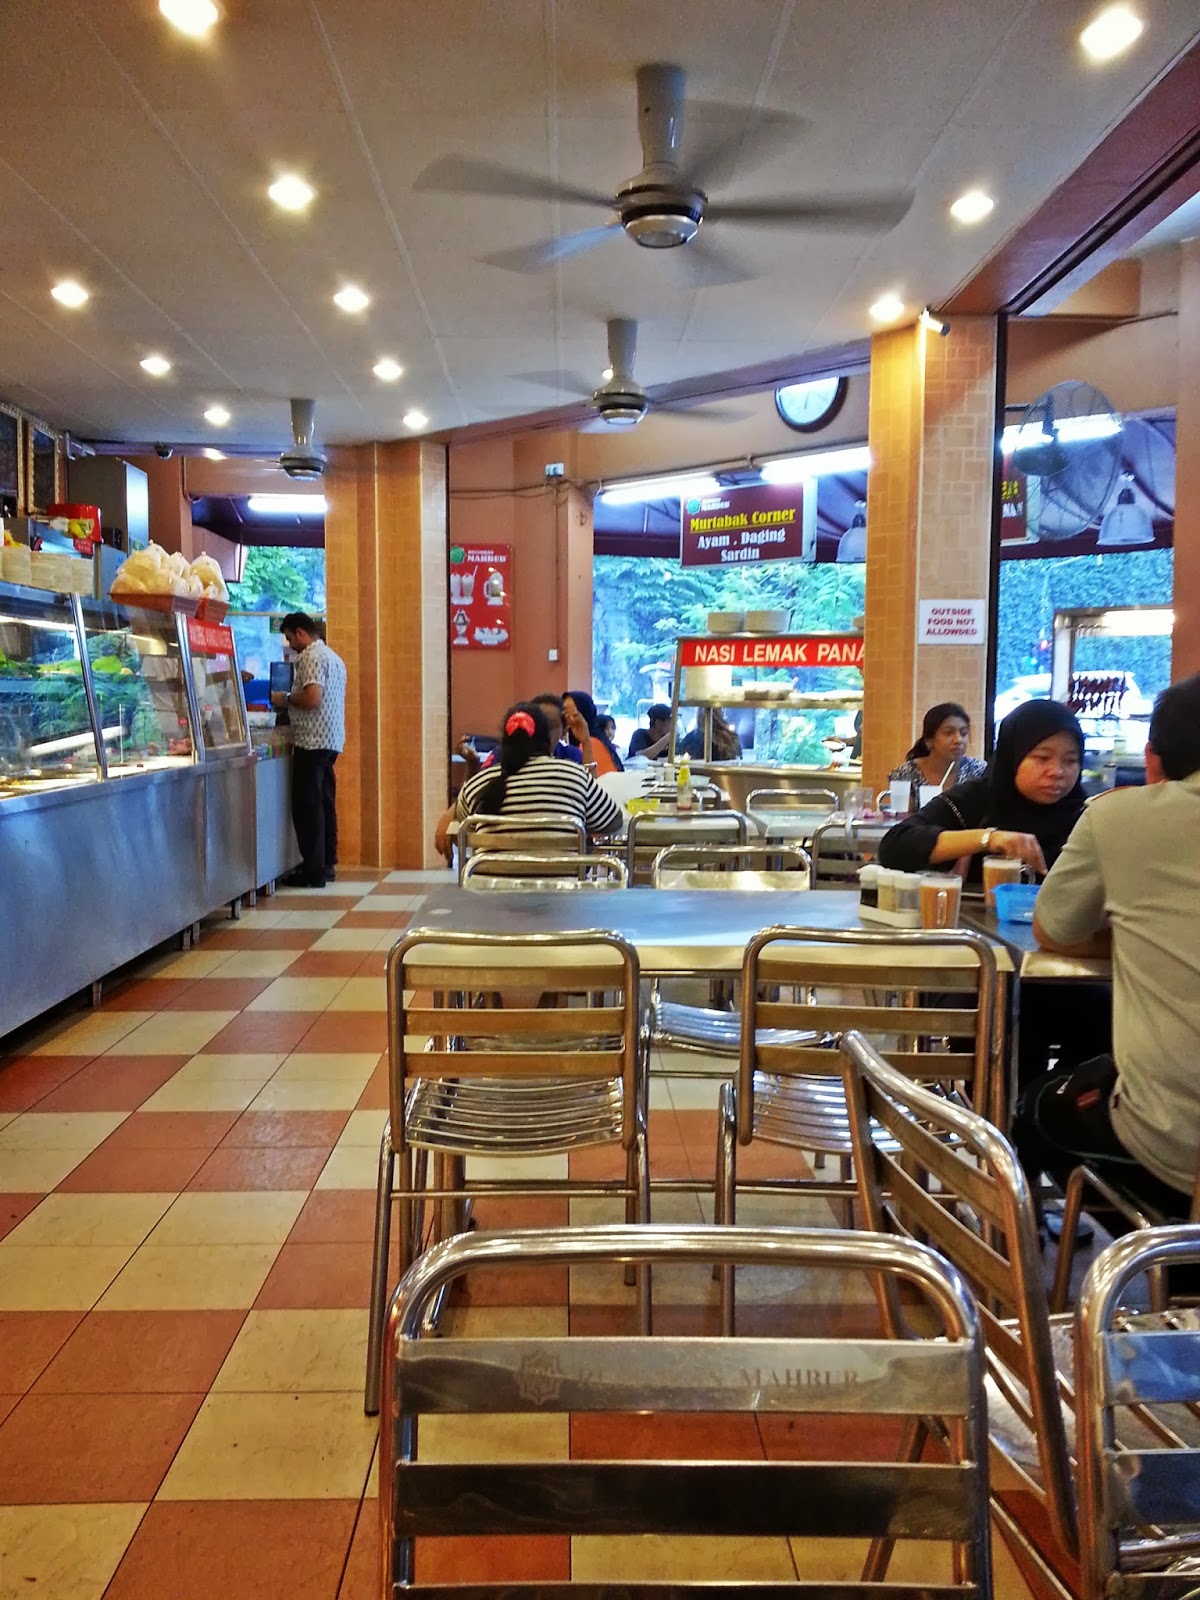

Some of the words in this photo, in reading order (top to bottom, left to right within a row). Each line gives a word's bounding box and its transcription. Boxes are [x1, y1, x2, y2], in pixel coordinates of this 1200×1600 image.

[690, 513, 748, 531] Murtabak
[752, 508, 796, 525] Corner
[698, 534, 730, 549] Ayam
[741, 528, 786, 544] Daging
[721, 547, 760, 562] Sardin
[695, 645, 735, 662] NASI
[743, 643, 808, 662] LEMAK
